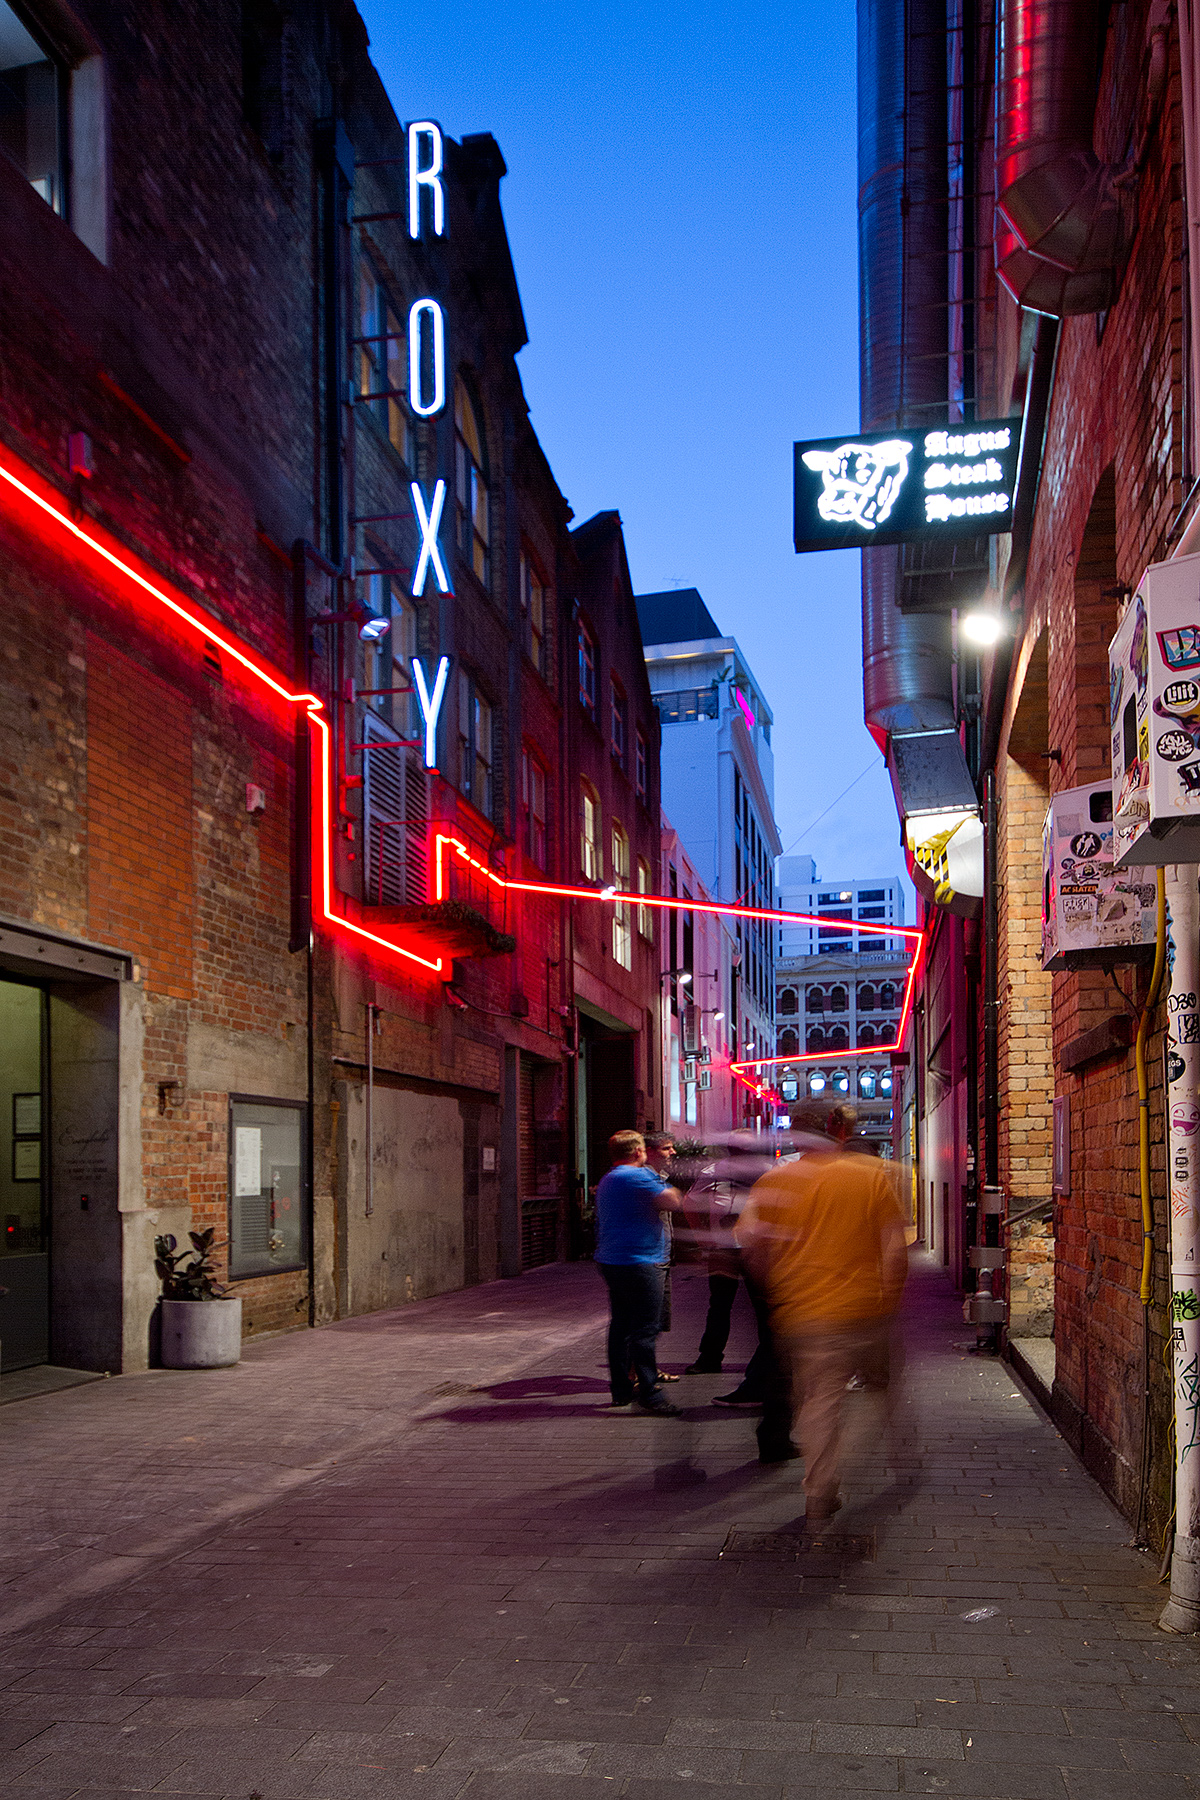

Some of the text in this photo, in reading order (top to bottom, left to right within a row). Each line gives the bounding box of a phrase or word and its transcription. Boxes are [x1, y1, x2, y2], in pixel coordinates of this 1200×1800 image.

[408, 120, 449, 769] ROXY
[924, 428, 1011, 457] Angus
[924, 458, 1003, 489] Steak
[924, 492, 1010, 522] House
[1167, 683, 1195, 702] Lilit
